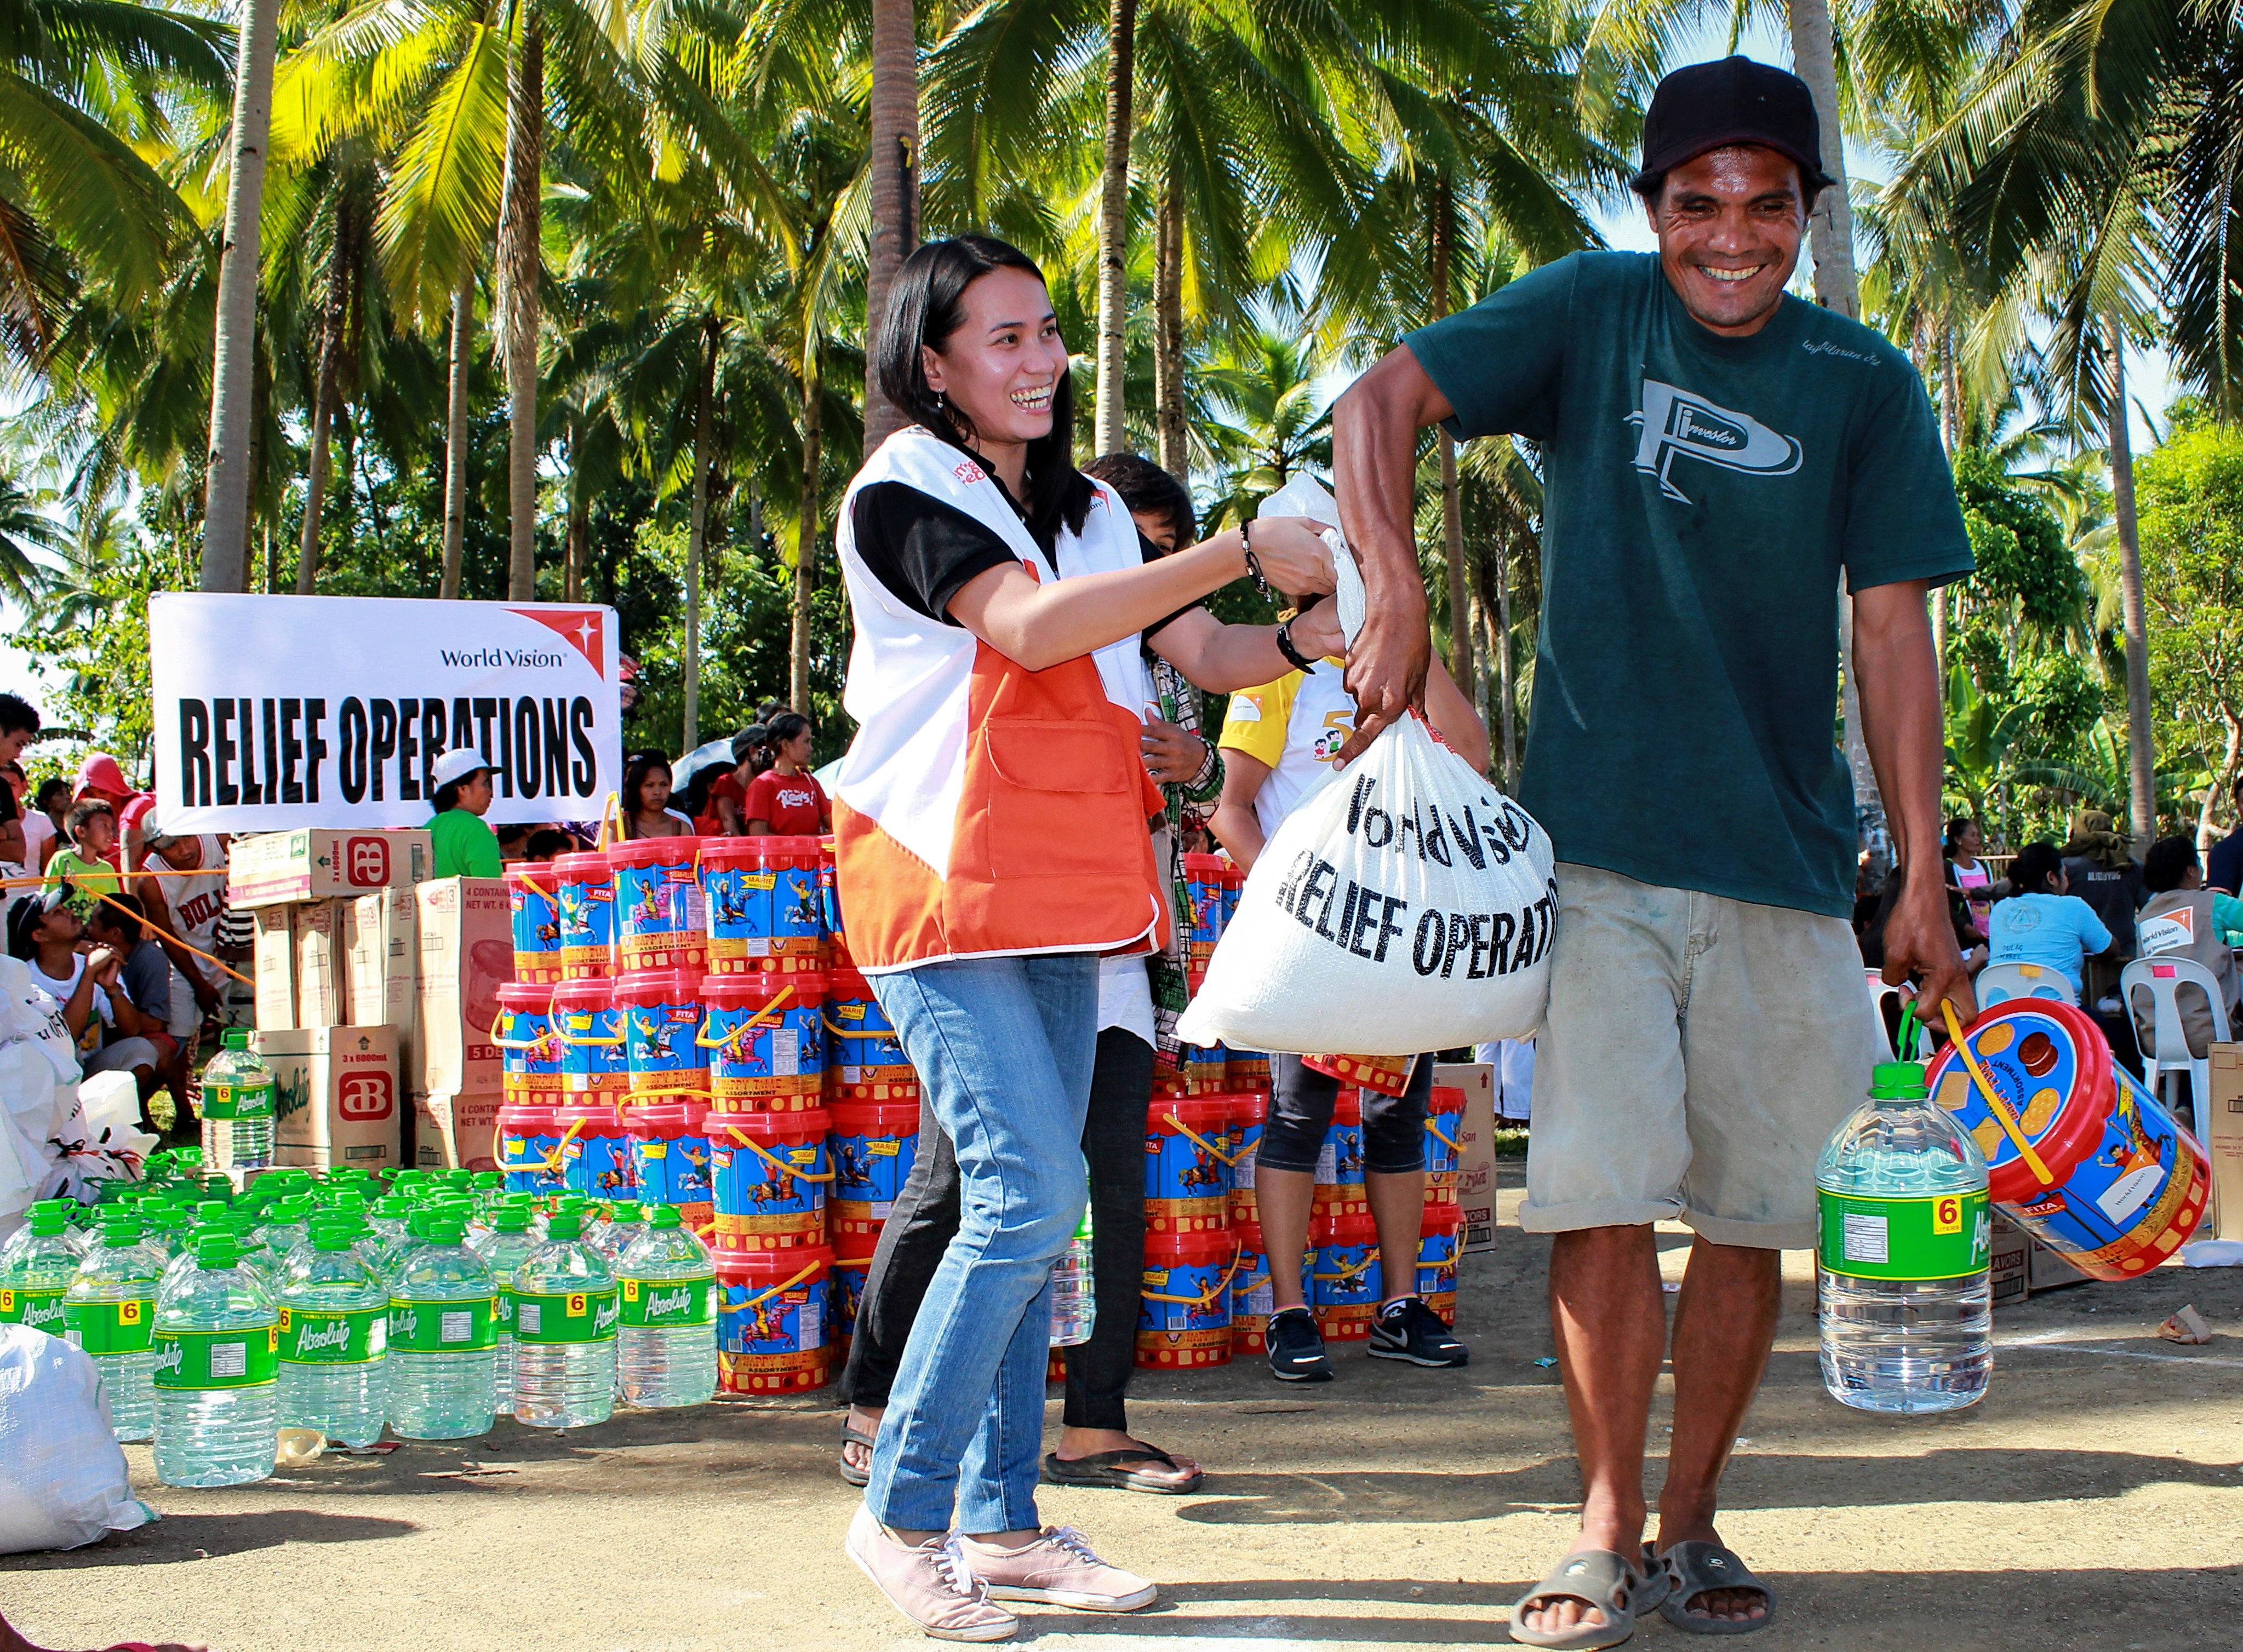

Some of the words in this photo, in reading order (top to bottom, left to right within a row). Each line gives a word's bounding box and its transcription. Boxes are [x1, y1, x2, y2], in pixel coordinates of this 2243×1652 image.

[440, 648, 502, 667] World
[505, 647, 563, 668] Vision
[1313, 710, 1357, 762] 5
[179, 697, 328, 807] RELIEF
[339, 695, 598, 804] OPERATIONS
[748, 876, 774, 885] MARIE
[449, 889, 455, 903] 3
[467, 887, 471, 896] 4
[593, 889, 611, 898] FITA
[466, 900, 480, 909] NET
[499, 900, 503, 909] 6
[1275, 848, 1407, 962] RELIEF
[1412, 877, 1559, 980] OPERATI
[2158, 926, 2178, 938] Vision
[634, 933, 663, 946] HAPPY
[639, 943, 692, 951] ASSORTMENT
[676, 1010, 695, 1018] FITA
[842, 1006, 863, 1015] MARIE
[343, 1054, 348, 1063] 3
[473, 1047, 481, 1058] 5
[721, 1079, 749, 1090] HAPPY
[1992, 1059, 2024, 1106] ASSORTMENT
[220, 1087, 230, 1099] 6
[461, 1106, 465, 1114] 4
[460, 1117, 476, 1127] NET
[1462, 1131, 1476, 1143] San
[873, 1143, 897, 1151] MARIE
[1146, 1141, 1158, 1150] ITA
[1938, 1198, 1958, 1225] 6
[2022, 1204, 2066, 1217] CRACKERS
[2023, 1201, 2058, 1214] FITA
[627, 1281, 636, 1296] 6
[3, 1291, 12, 1306] 6
[571, 1295, 585, 1311] 6
[644, 1286, 691, 1323] Absolute
[21, 1296, 68, 1328] Absolut
[123, 1303, 138, 1318] 6
[280, 1310, 290, 1327] 6
[271, 1327, 278, 1344] 6
[295, 1319, 351, 1358] Absolute
[743, 1355, 776, 1368] HAPPY
